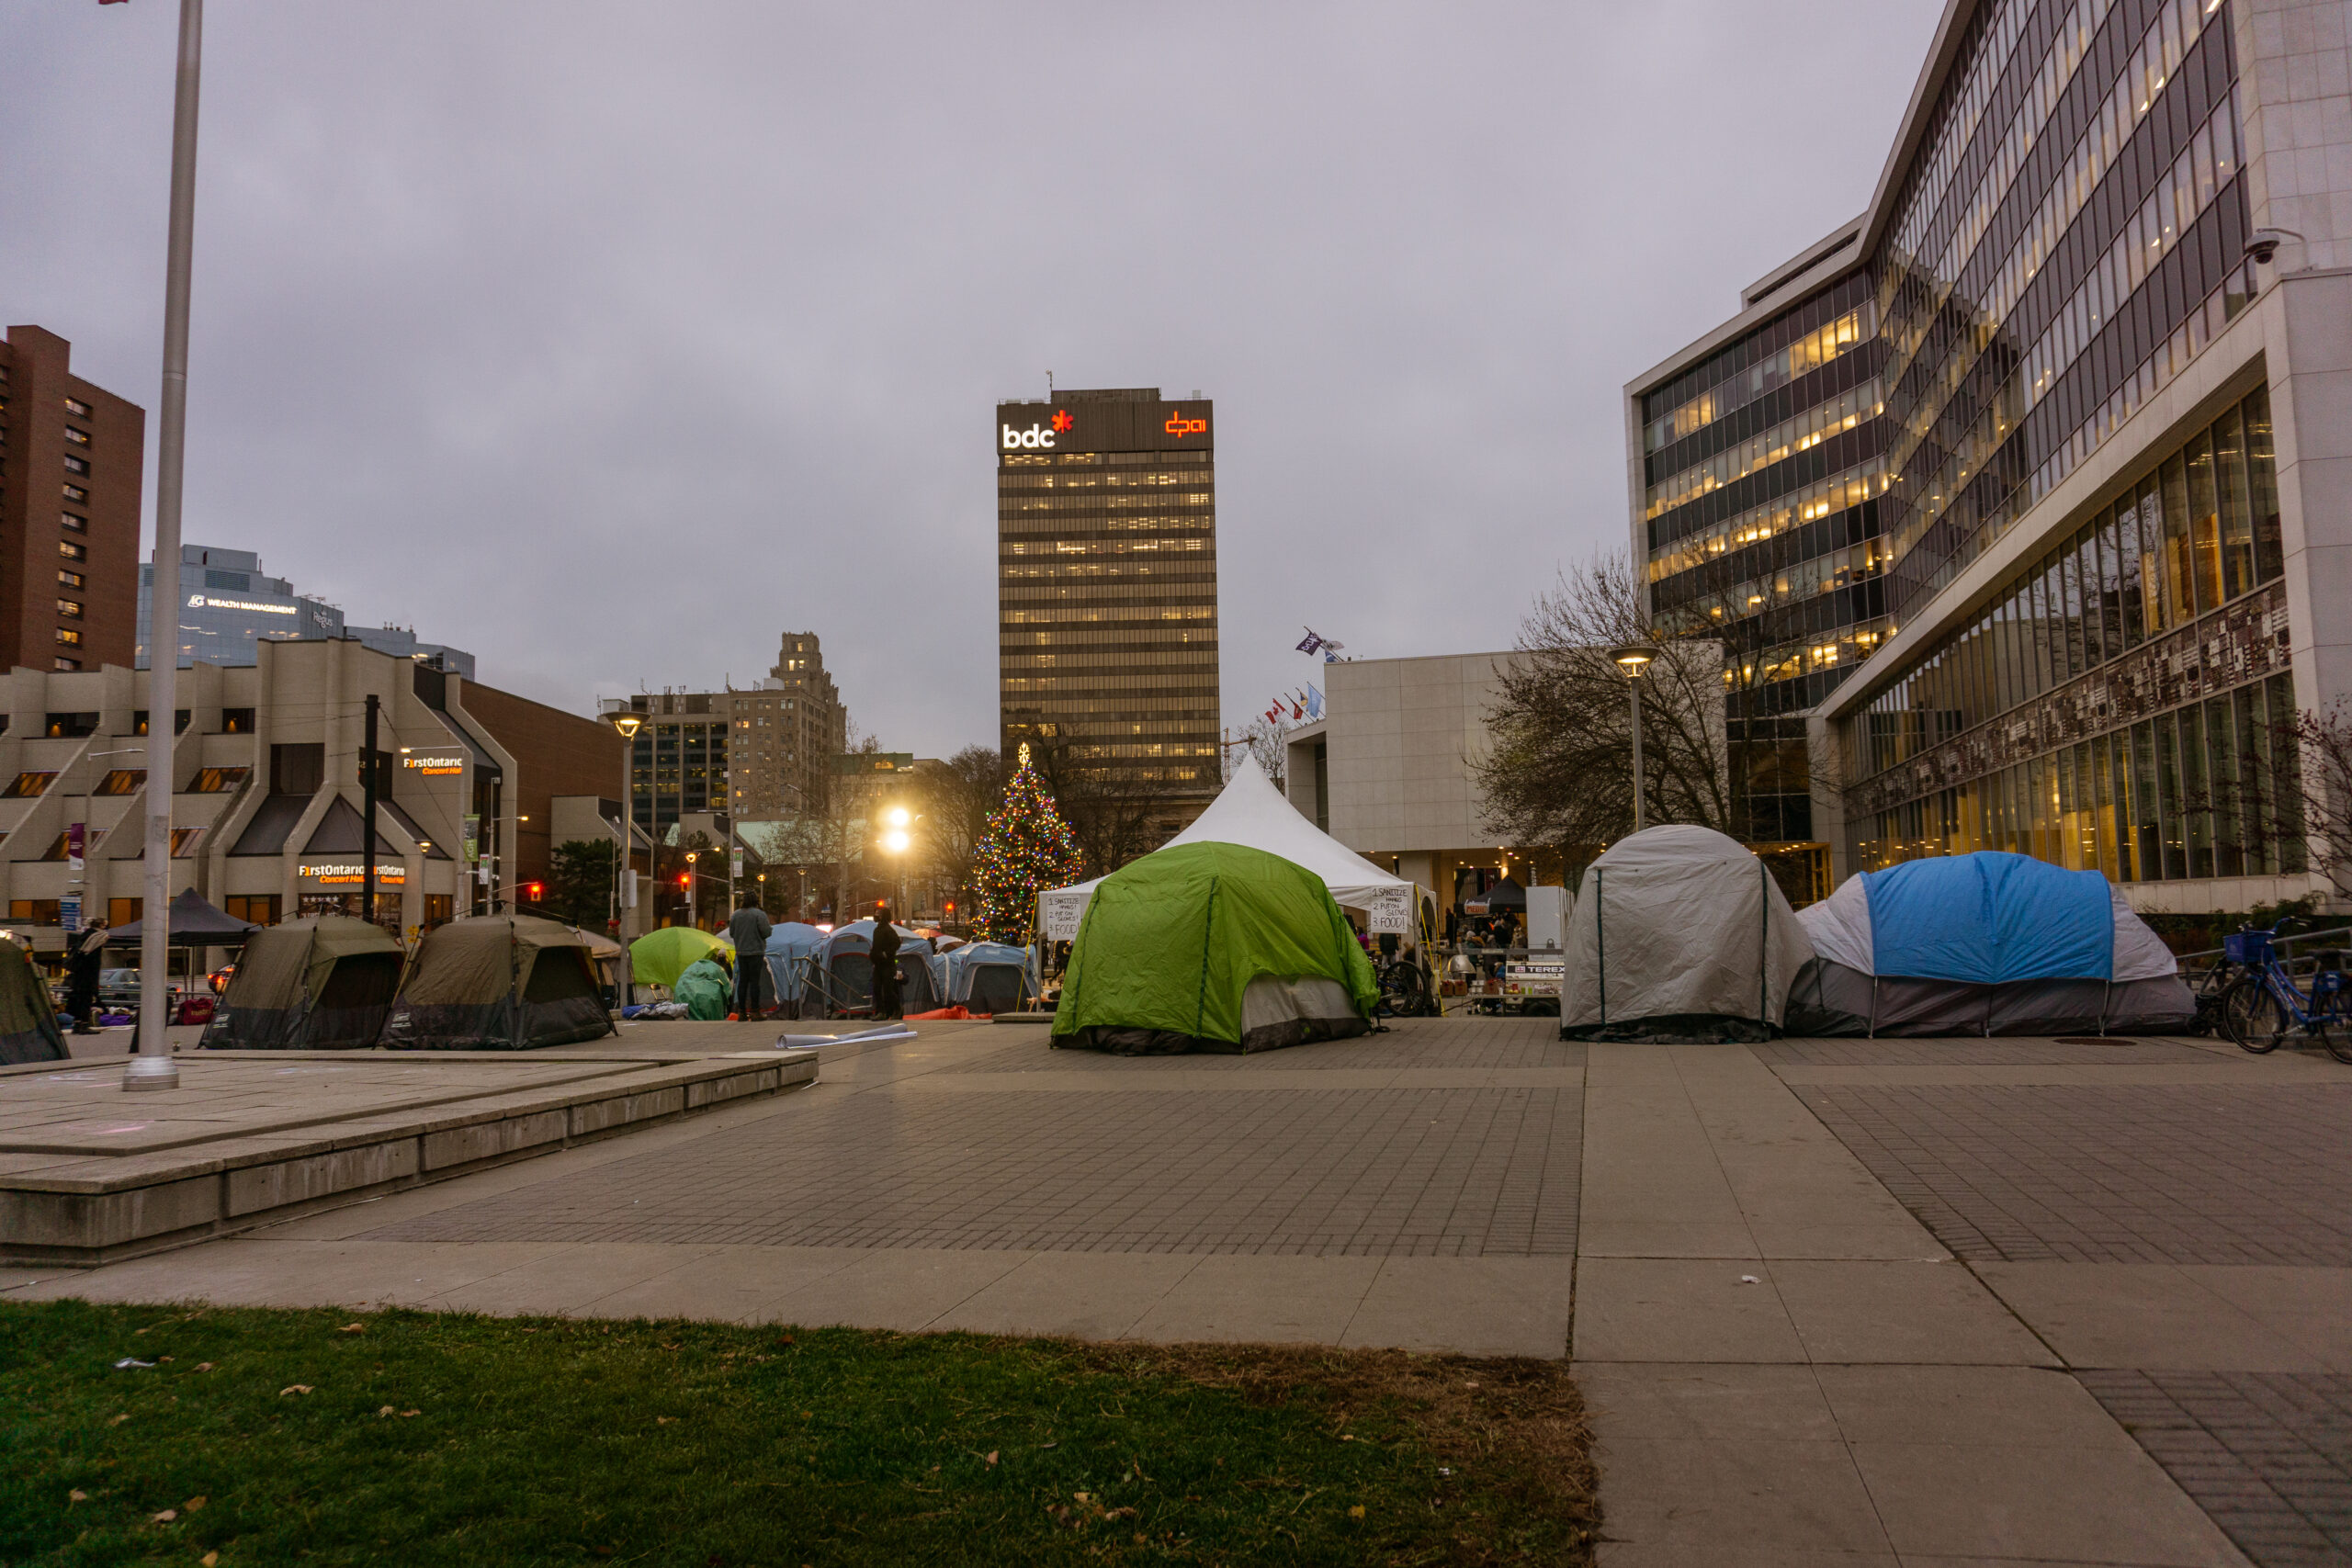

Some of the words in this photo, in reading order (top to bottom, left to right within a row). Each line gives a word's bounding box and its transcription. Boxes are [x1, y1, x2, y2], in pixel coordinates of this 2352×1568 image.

[1002, 423, 1056, 448] bdc
[207, 598, 240, 609] WEALTH
[241, 602, 298, 615] MANAGEMENT
[312, 611, 334, 628] Regus
[1379, 887, 1408, 897] SANITIZE
[1380, 916, 1405, 930] FOOD!
[1527, 965, 1565, 974] TEREX
